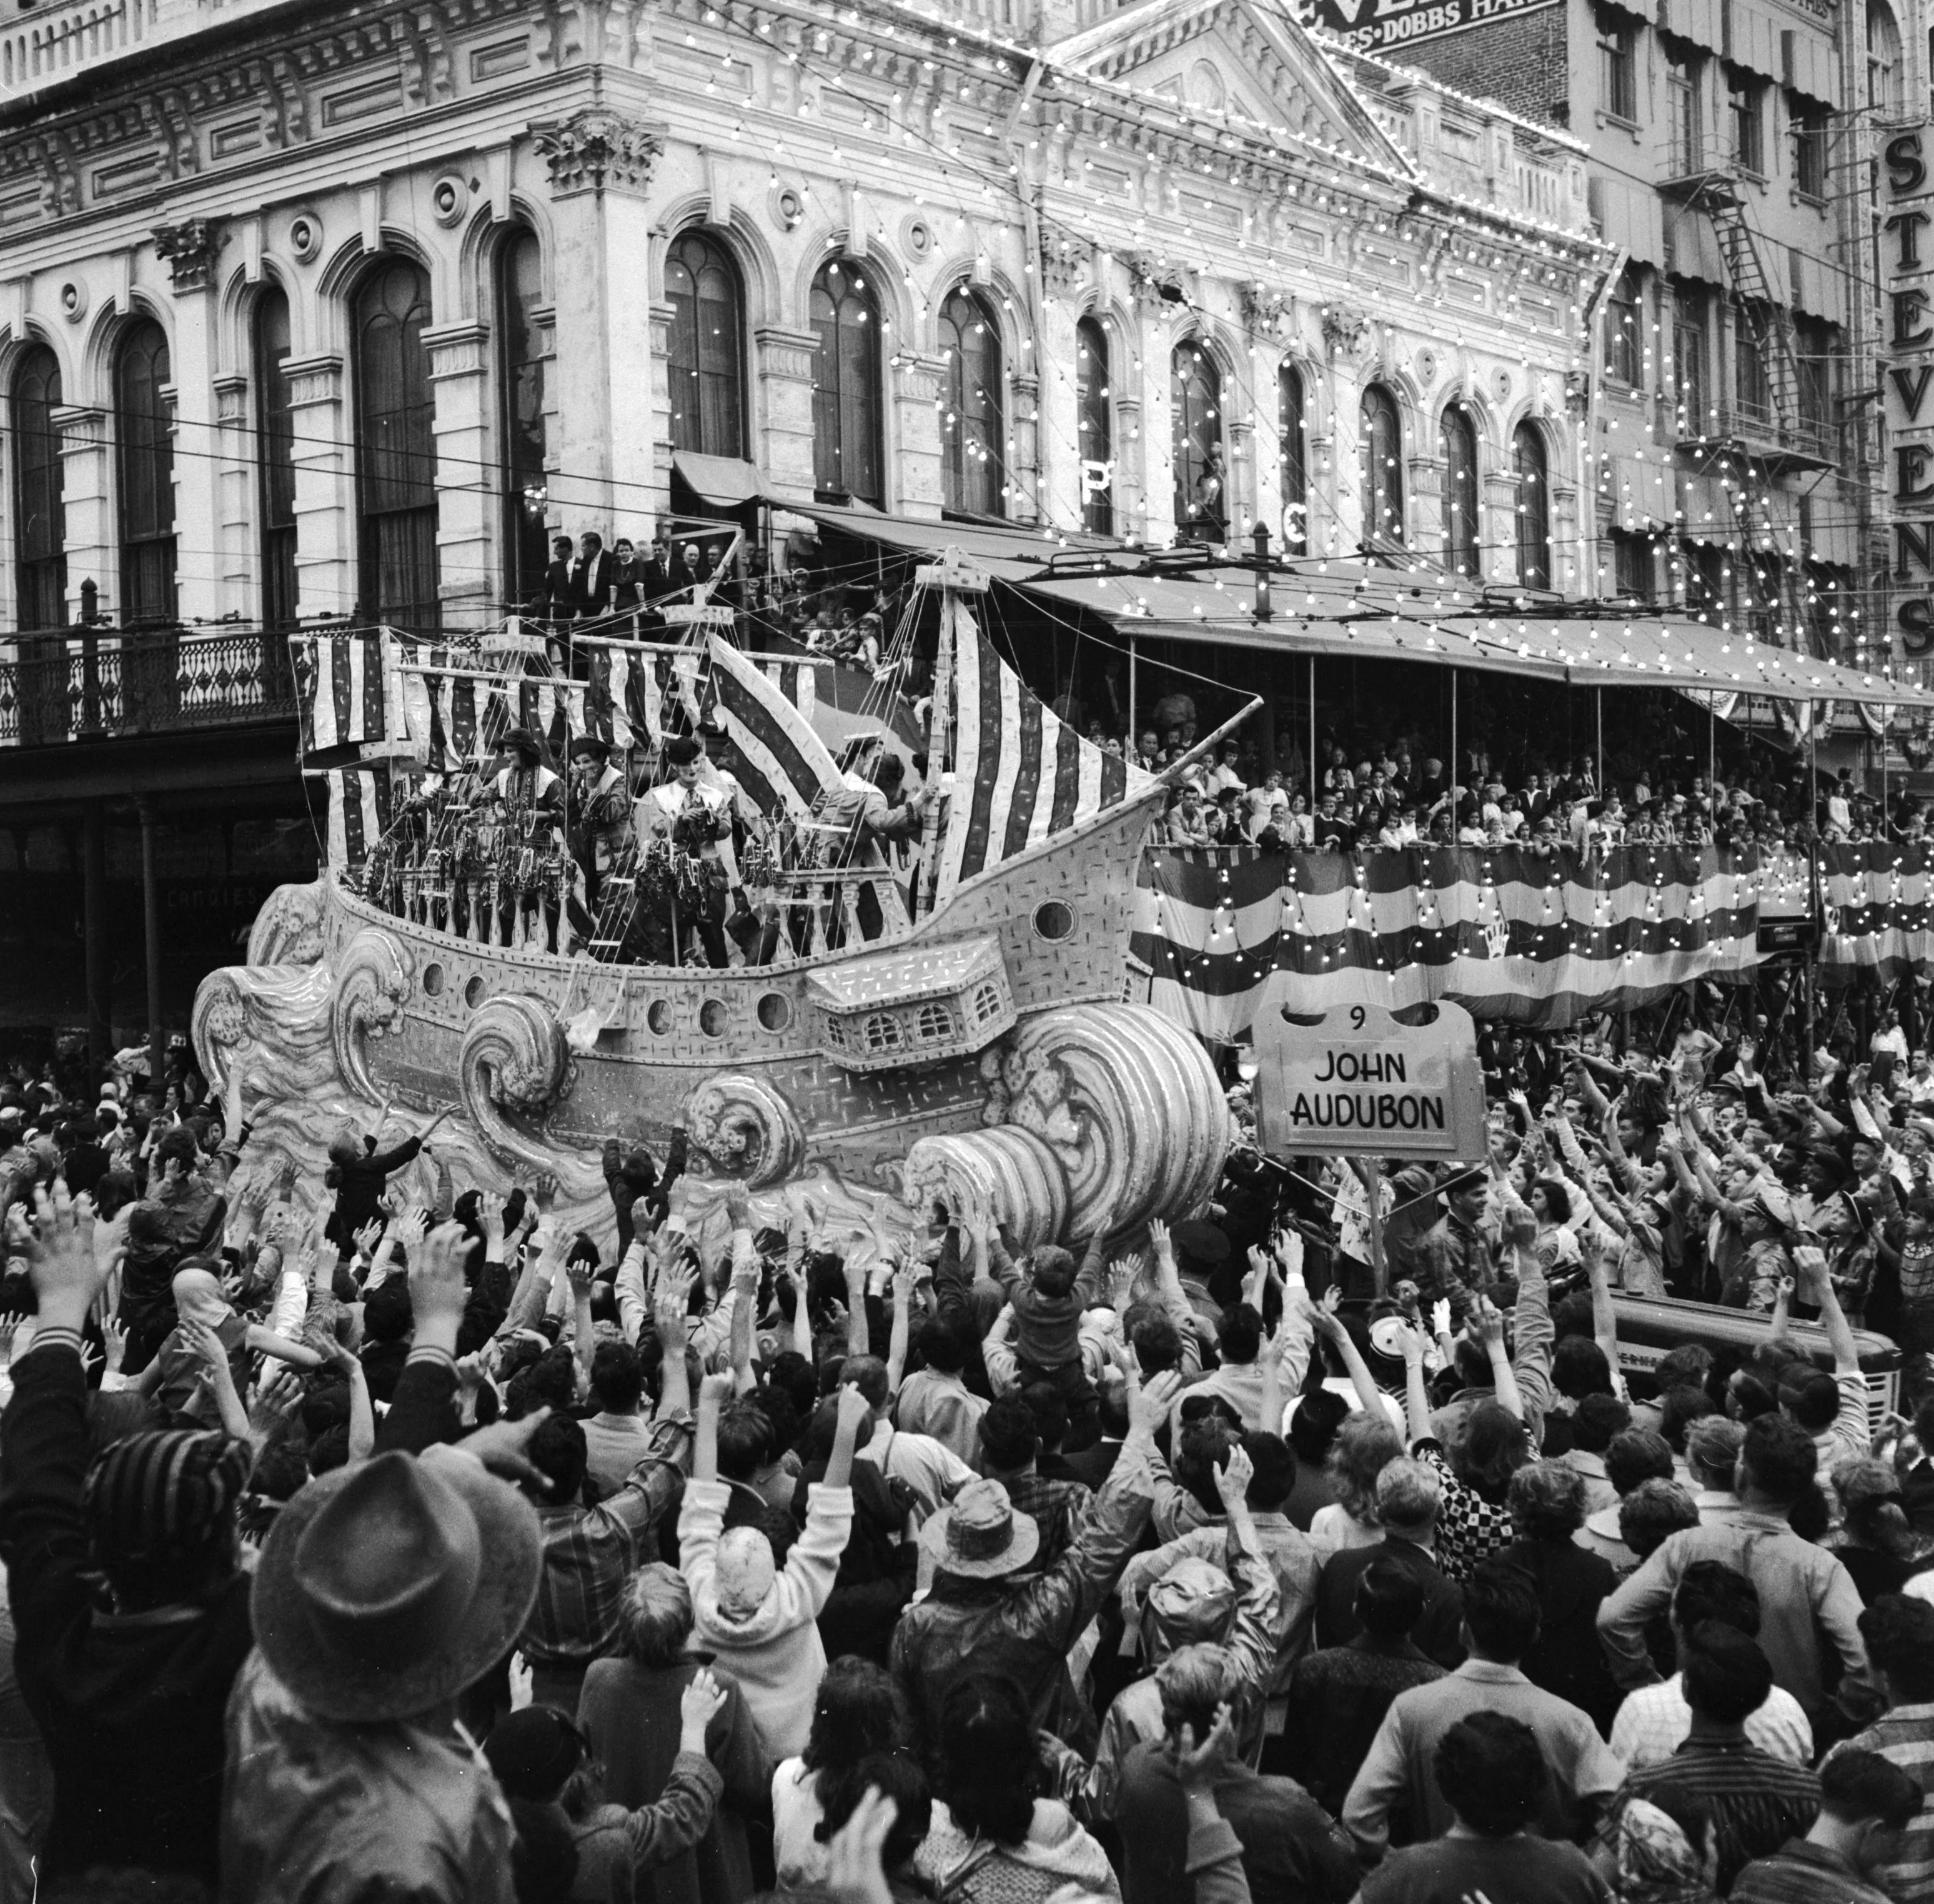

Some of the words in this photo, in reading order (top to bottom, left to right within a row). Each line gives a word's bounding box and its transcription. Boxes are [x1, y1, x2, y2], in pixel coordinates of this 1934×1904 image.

[1382, 1, 1461, 44] DOBBS
[1883, 133, 1934, 657] STEVENS
[1081, 460, 1114, 505] P
[1350, 1006, 1366, 1030] 9
[1314, 1050, 1406, 1083] JOHN
[1289, 1093, 1445, 1129] AUDUBON
